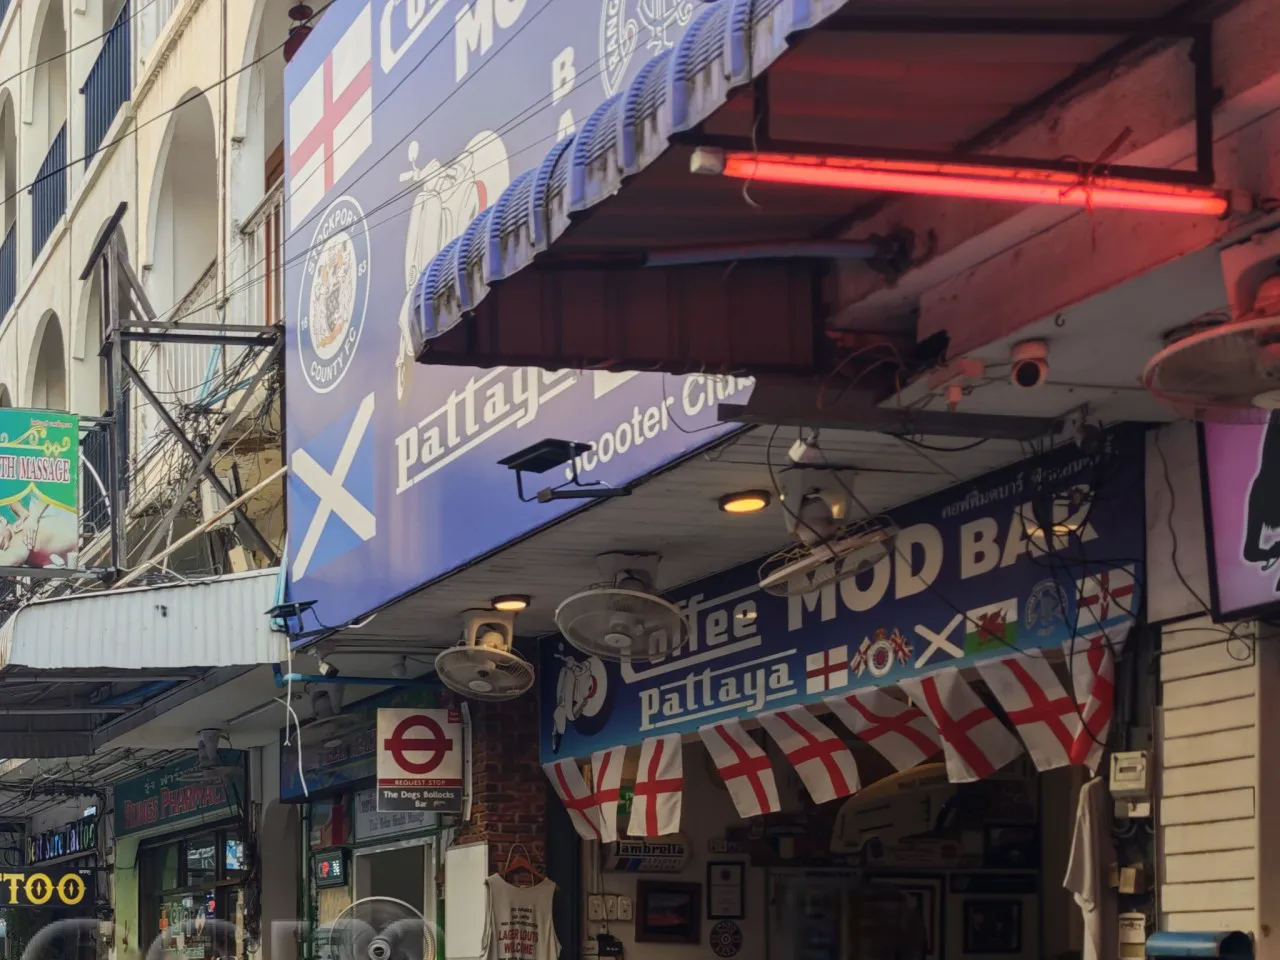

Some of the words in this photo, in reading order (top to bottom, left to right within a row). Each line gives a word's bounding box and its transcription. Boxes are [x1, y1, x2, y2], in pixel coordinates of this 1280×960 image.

[310, 359, 344, 383] COUNTY
[394, 366, 578, 496] Pattay
[19, 456, 72, 484] MASSAGE
[639, 652, 797, 733] Pattaya
[383, 791, 398, 799] The
[401, 791, 421, 799] Dogs
[423, 791, 455, 799] Bollocks
[415, 800, 428, 808] Bar
[498, 929, 519, 941] LAGER
[520, 931, 539, 943] LOUTS
